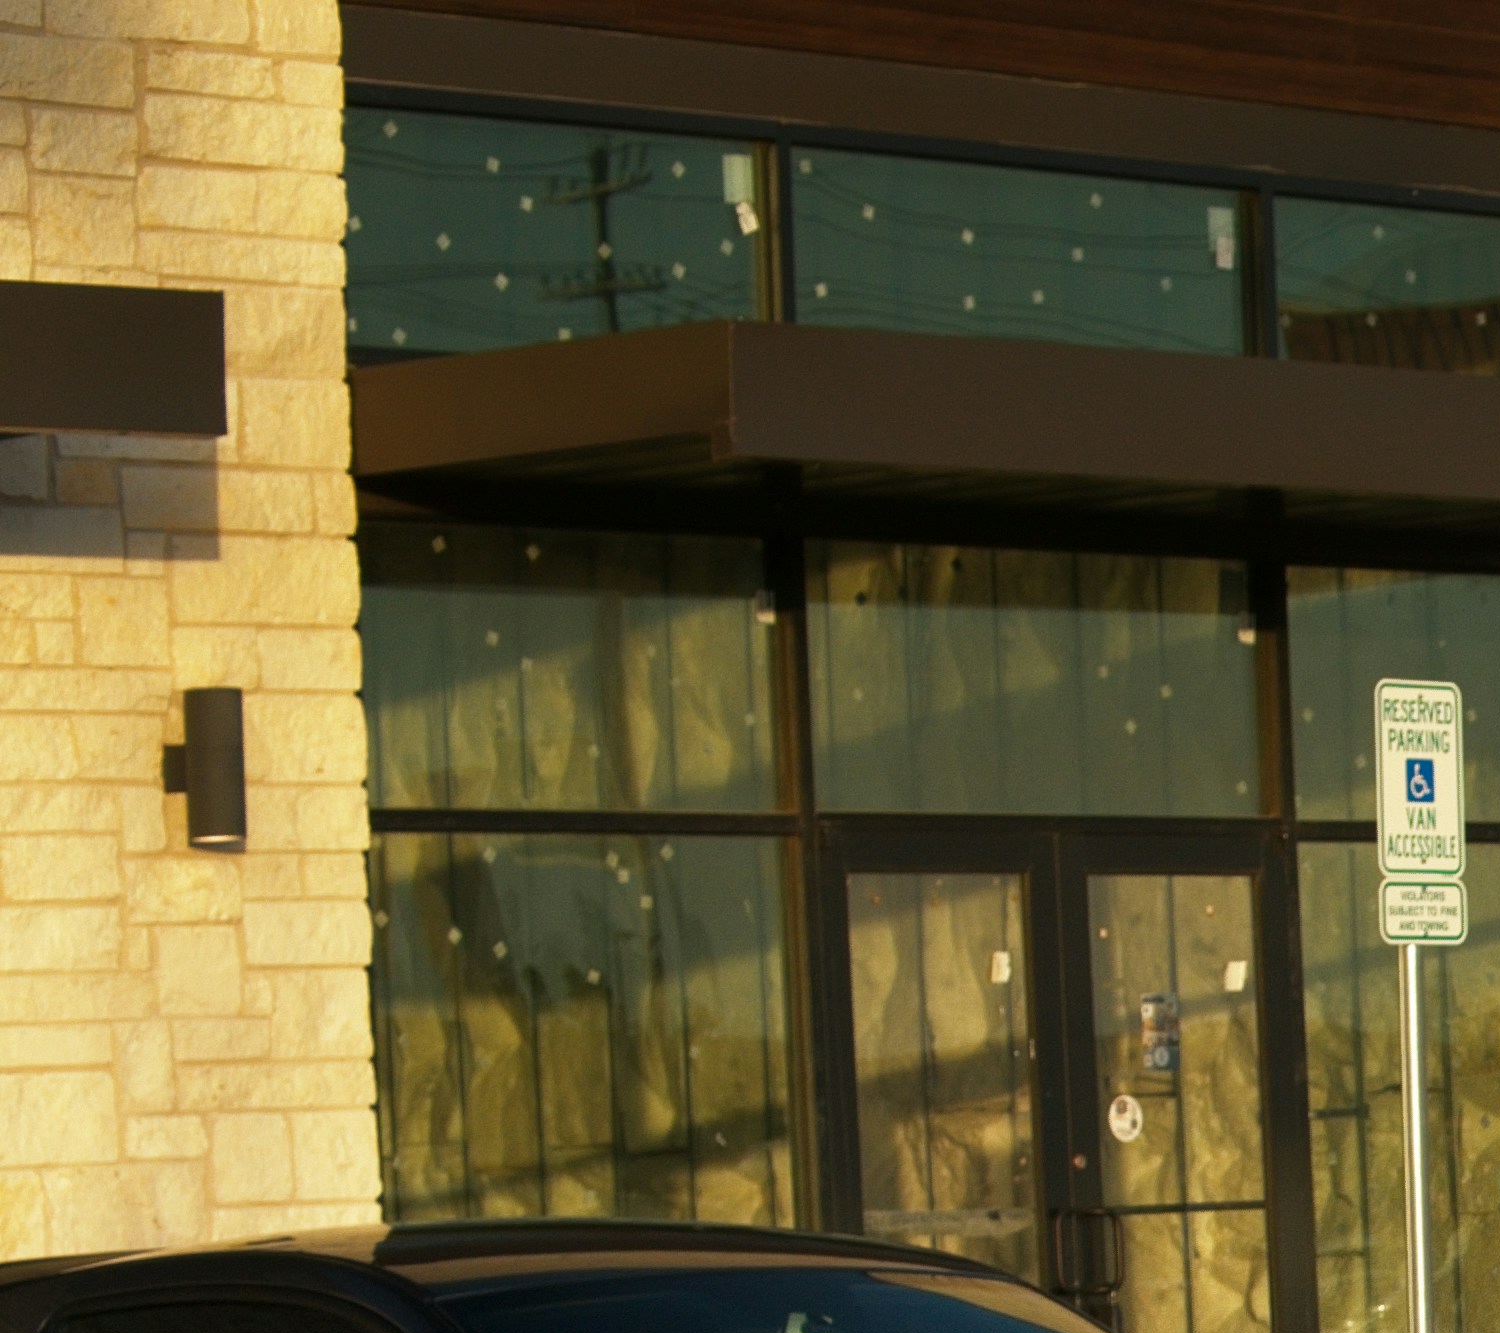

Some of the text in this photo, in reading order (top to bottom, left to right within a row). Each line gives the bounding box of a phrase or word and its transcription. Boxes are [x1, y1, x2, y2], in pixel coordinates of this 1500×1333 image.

[1383, 699, 1454, 724] RESERVED
[1387, 729, 1451, 753] PARKING
[1406, 806, 1437, 829] VAN
[1387, 834, 1457, 858] ACCESSIBLE
[1400, 890, 1446, 902] VIOLATORS
[1389, 905, 1458, 917] SUBJECT TO FINE
[1398, 919, 1449, 932] AND TOWING
